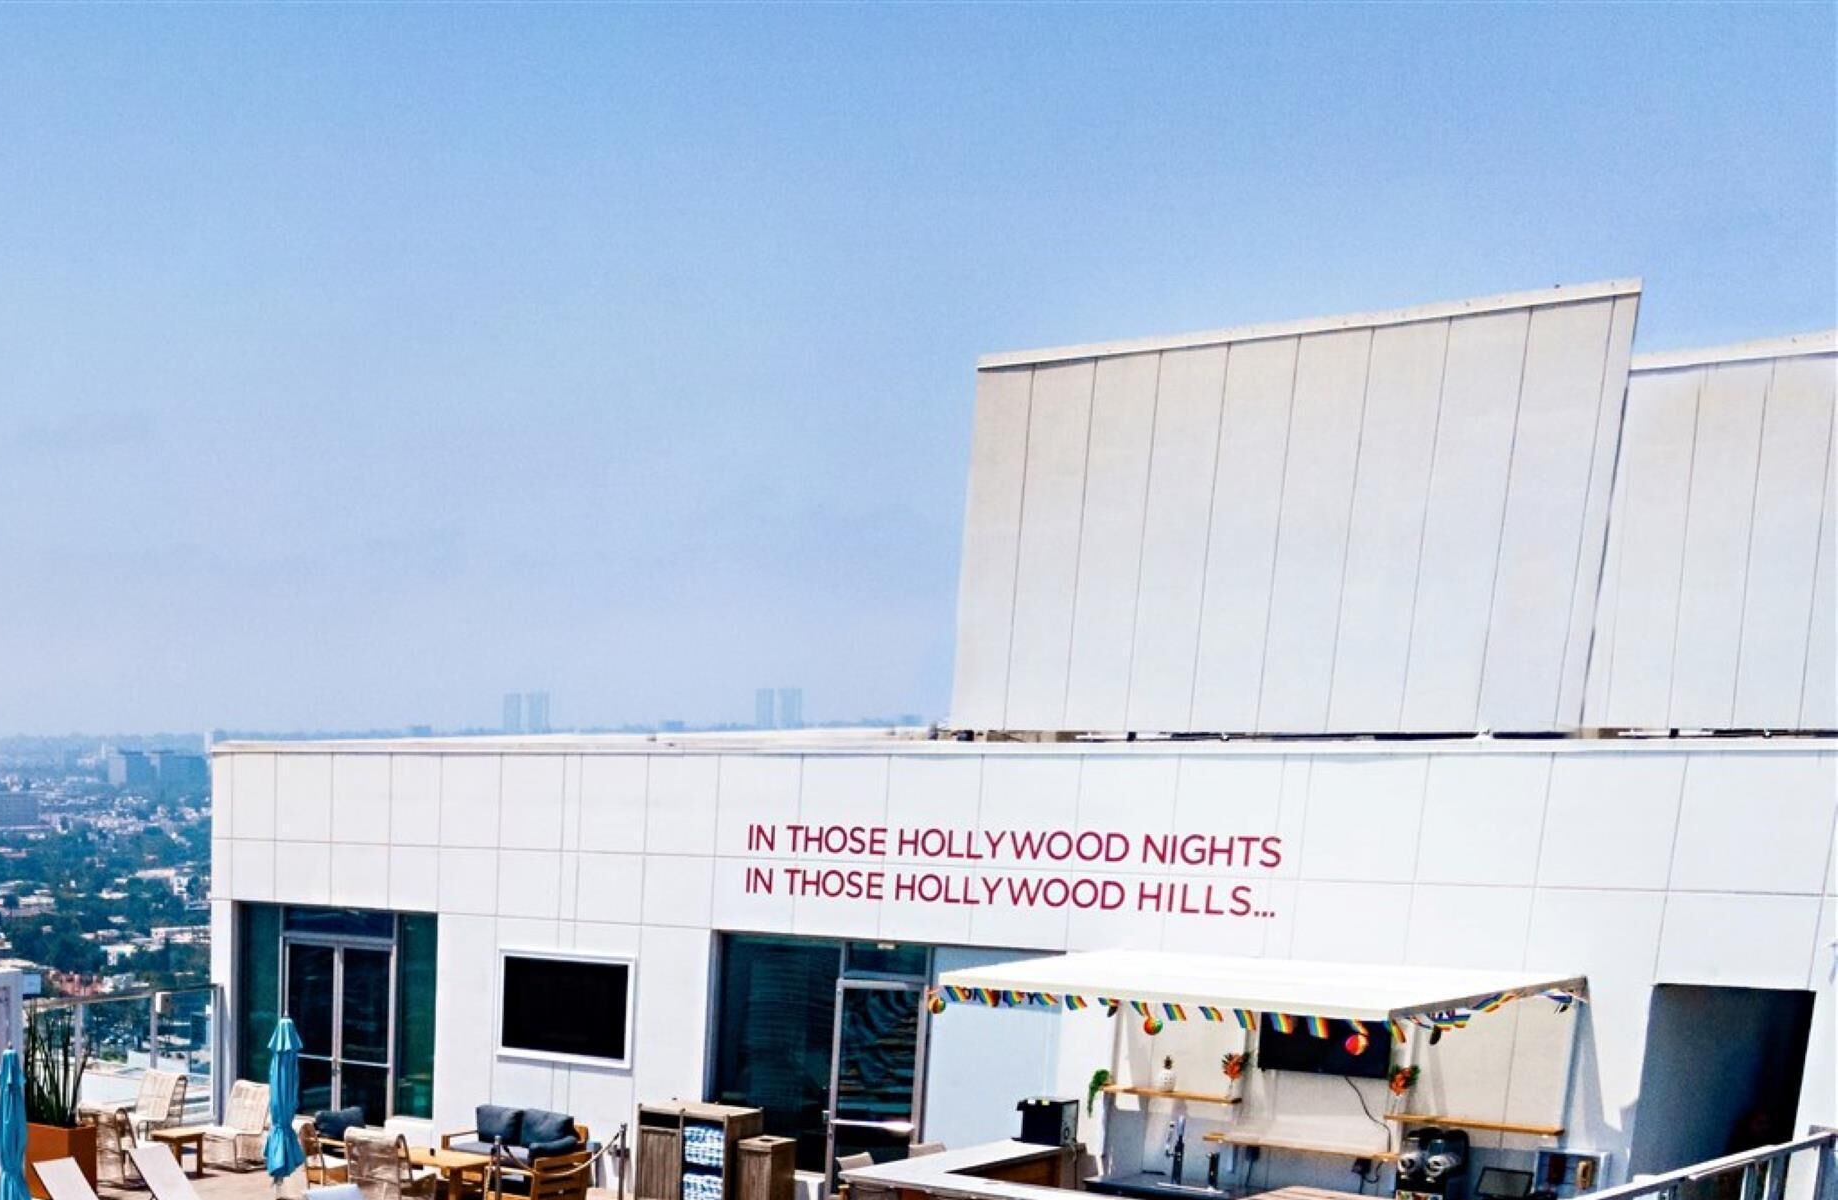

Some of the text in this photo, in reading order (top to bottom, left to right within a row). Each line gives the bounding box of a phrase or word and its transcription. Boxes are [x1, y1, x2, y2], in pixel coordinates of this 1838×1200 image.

[748, 824, 1283, 869] IN THOSE HOLLYWOOD NIGHTS
[745, 868, 1277, 918] IN THOSE HOLLYWOOD HILLS...
